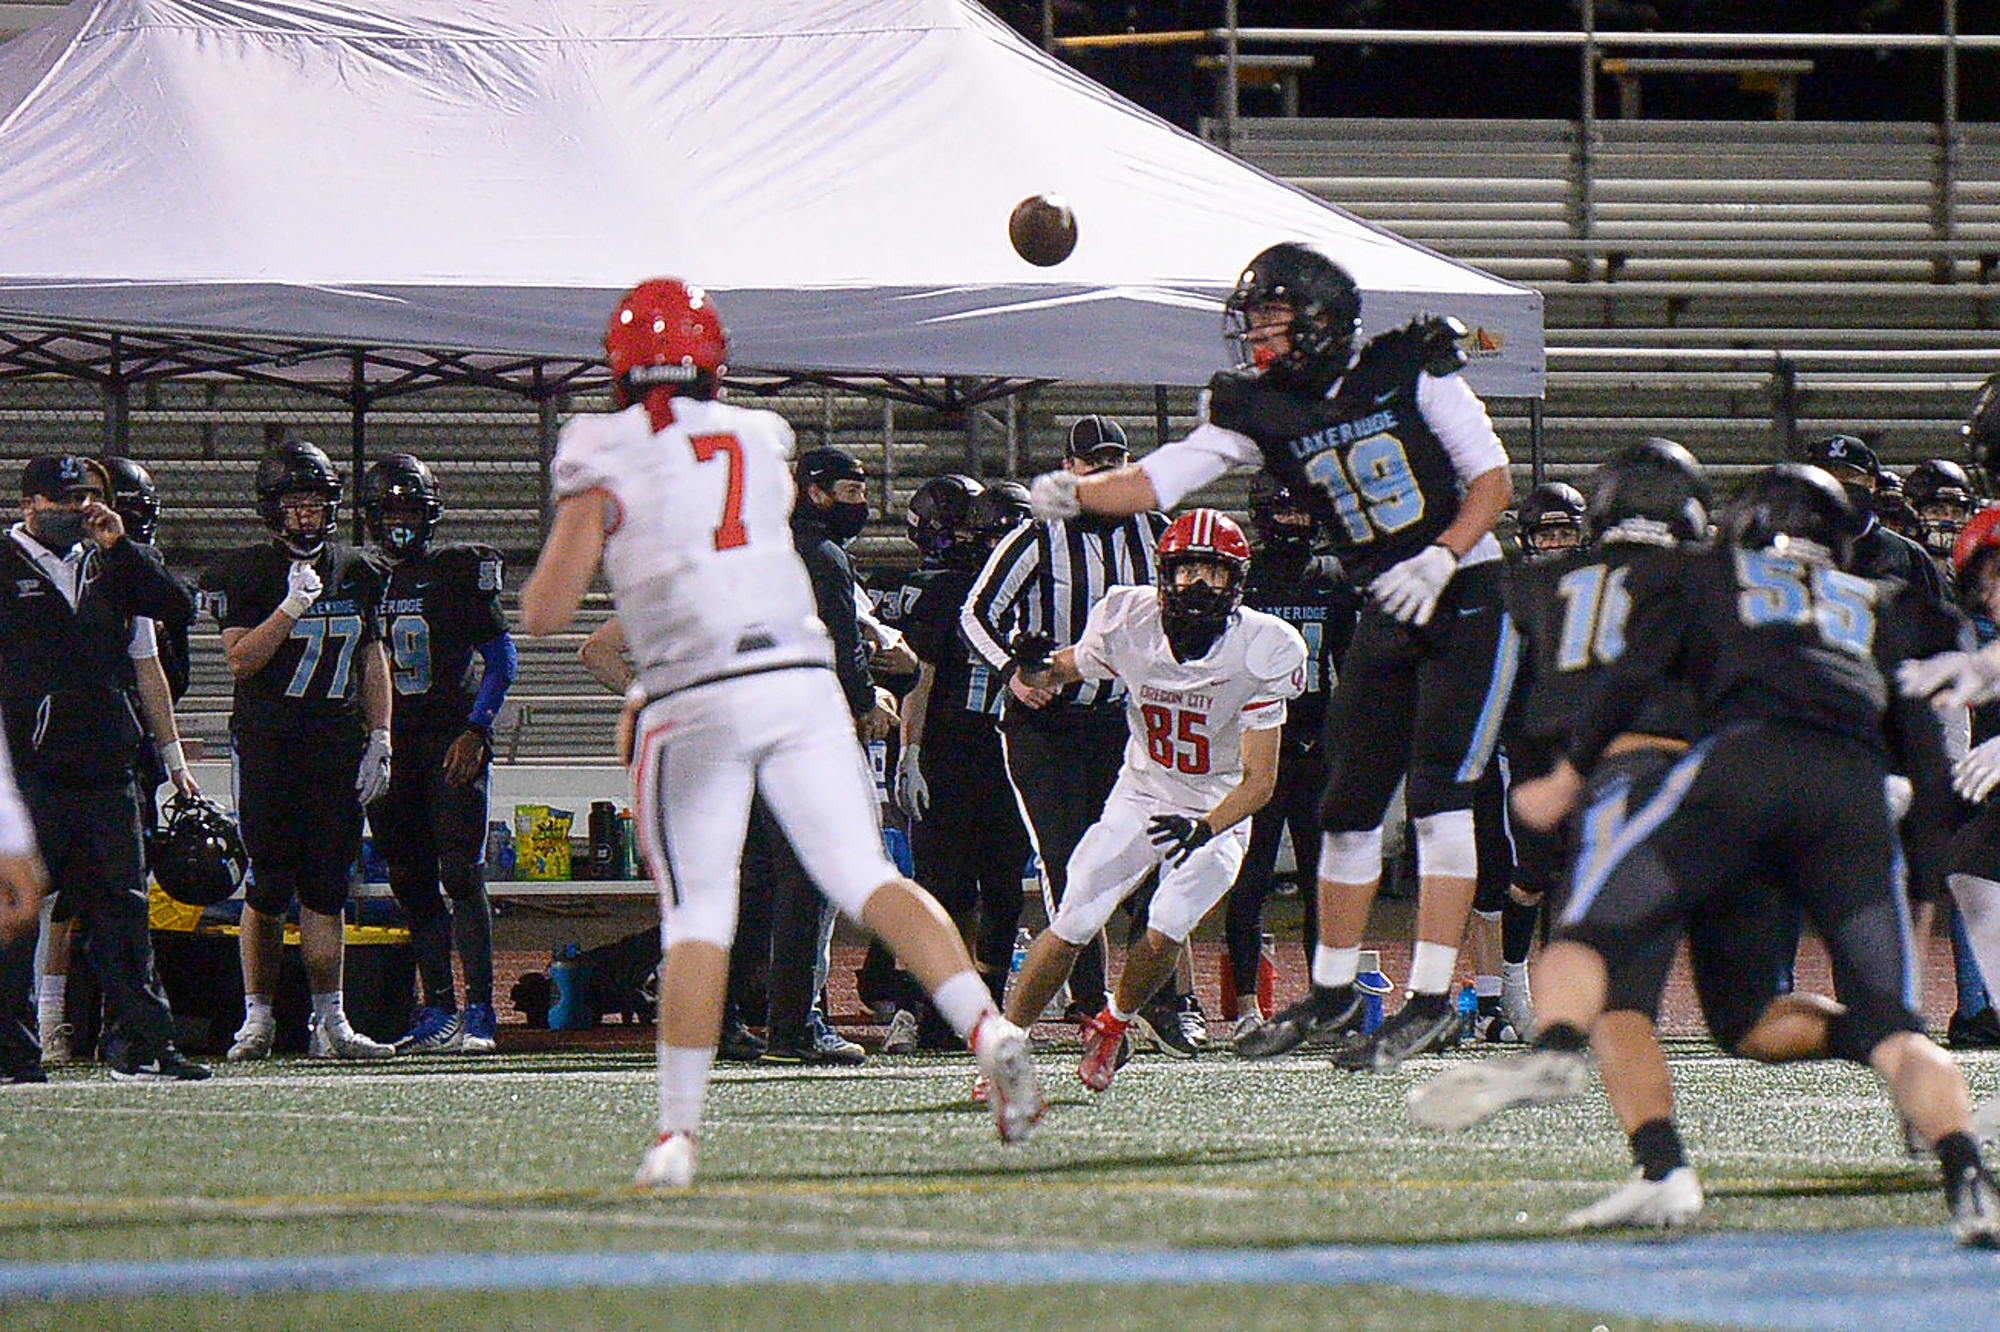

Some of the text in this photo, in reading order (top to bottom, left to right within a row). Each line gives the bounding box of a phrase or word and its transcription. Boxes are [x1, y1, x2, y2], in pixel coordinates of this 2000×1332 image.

[689, 432, 748, 551] 7
[1305, 431, 1425, 543] 19
[374, 598, 424, 614] ERIDGE
[1735, 551, 1877, 657] 55
[285, 614, 363, 698] 77
[1140, 703, 1211, 775] 85
